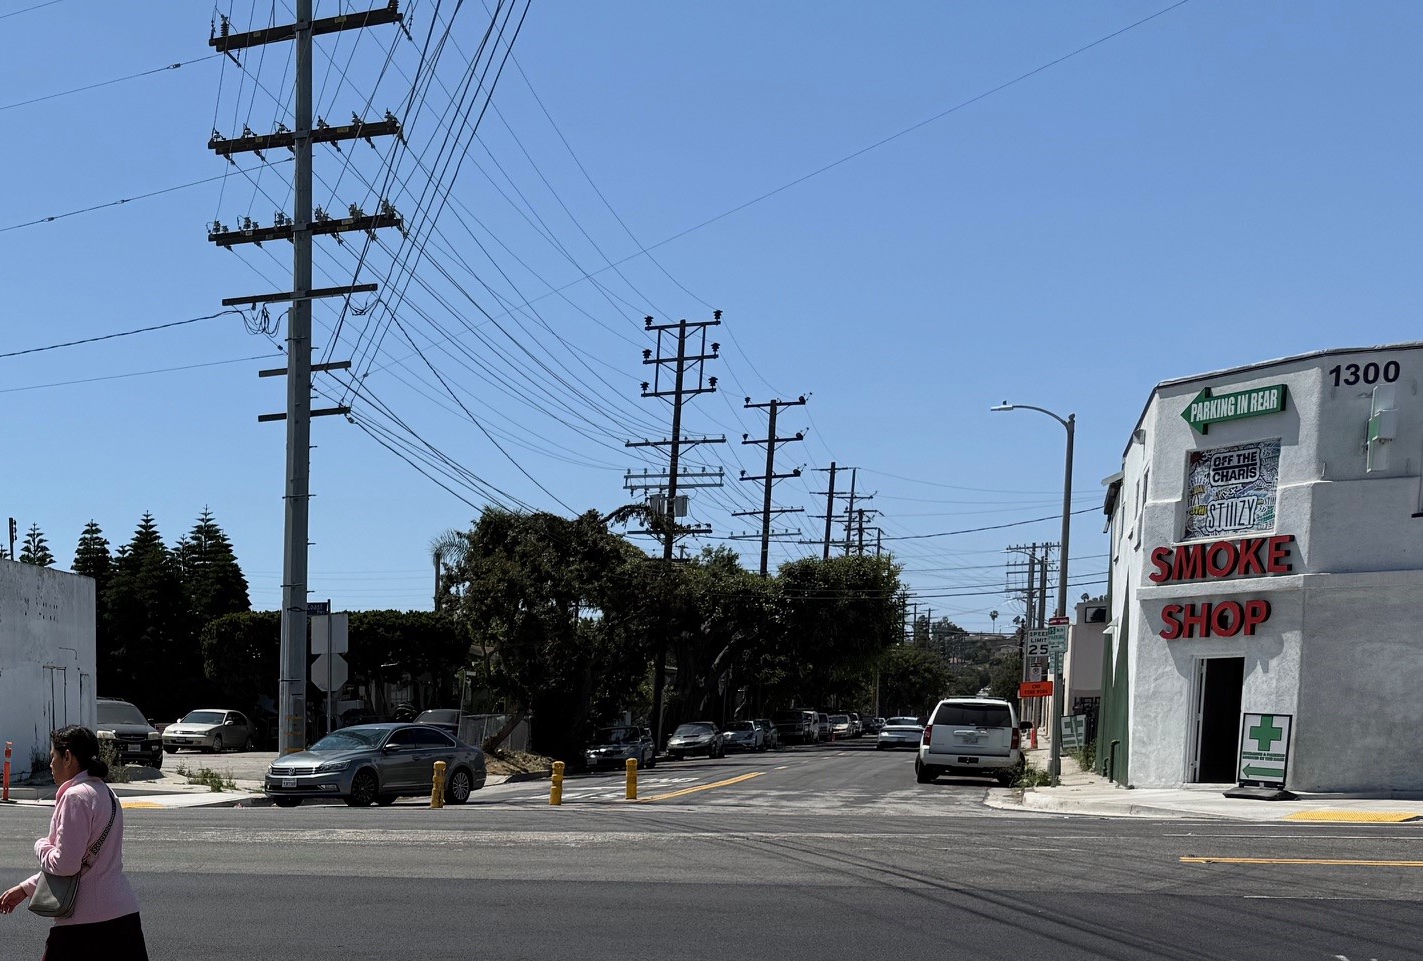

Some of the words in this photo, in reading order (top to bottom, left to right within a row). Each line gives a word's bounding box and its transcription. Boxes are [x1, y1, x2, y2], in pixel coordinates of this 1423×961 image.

[1329, 360, 1400, 387] 1300
[1190, 396, 1235, 423] PARKING
[1236, 394, 1248, 415] IN
[1250, 389, 1278, 412] REAR
[1213, 454, 1234, 467] OFF
[1236, 451, 1257, 464] THE
[1212, 466, 1257, 483] CHARTS
[1208, 498, 1255, 529] STIIIZY
[1149, 534, 1295, 584] SMOKE
[1159, 600, 1271, 640] SHOP
[1028, 644, 1048, 655] 25
